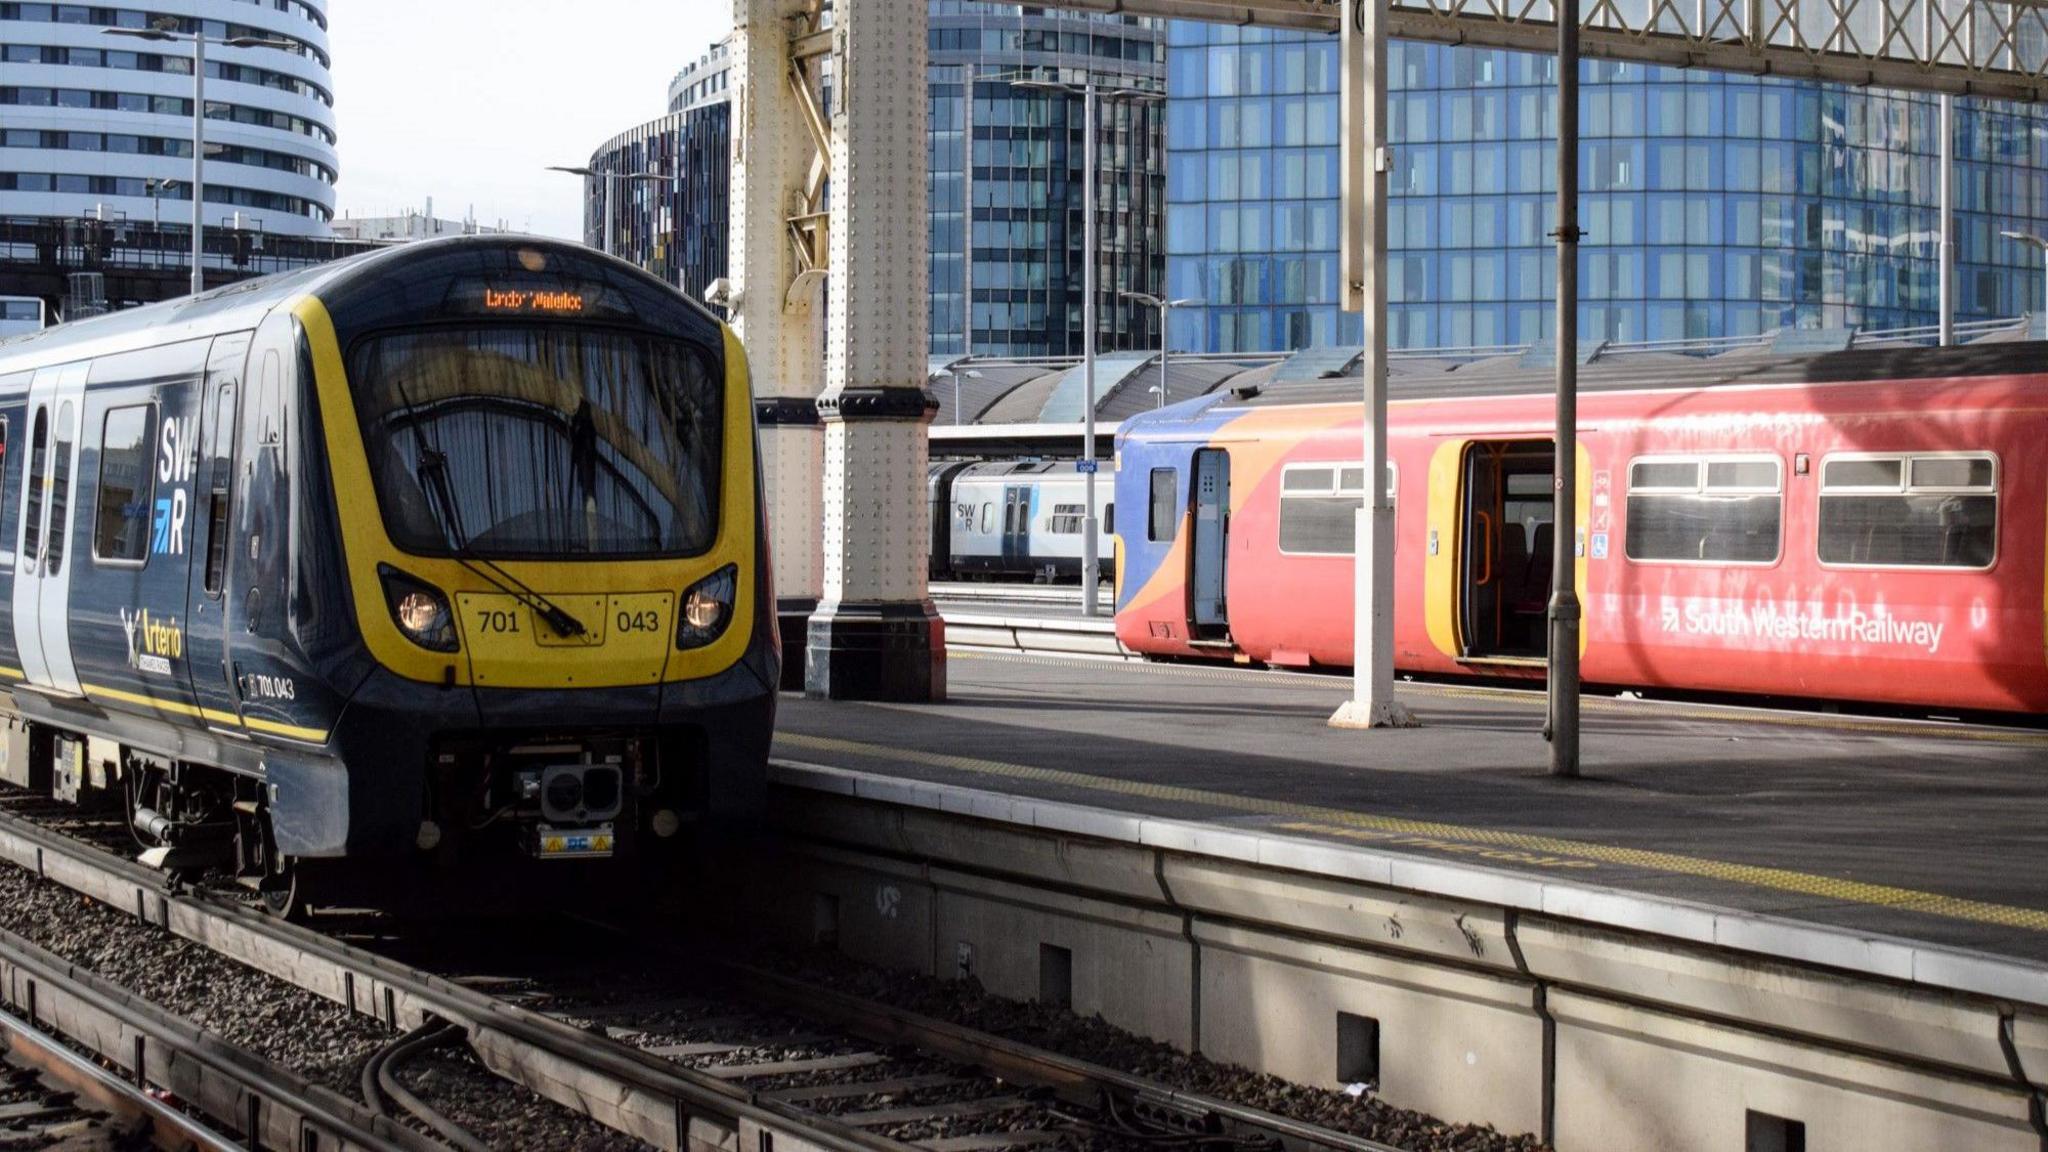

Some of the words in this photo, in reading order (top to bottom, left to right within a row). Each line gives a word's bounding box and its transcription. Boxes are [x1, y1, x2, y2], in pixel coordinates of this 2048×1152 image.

[160, 416, 196, 483] SW
[170, 488, 187, 555] R
[957, 503, 976, 518] SW
[965, 519, 973, 532] R
[143, 607, 181, 658] Arterio
[477, 611, 520, 633] 701
[617, 611, 659, 633] 043
[1684, 602, 1748, 636] South
[1751, 606, 1851, 640] Western
[1852, 611, 1944, 653] Railway
[256, 674, 275, 697] 701
[274, 676, 295, 700] 043
